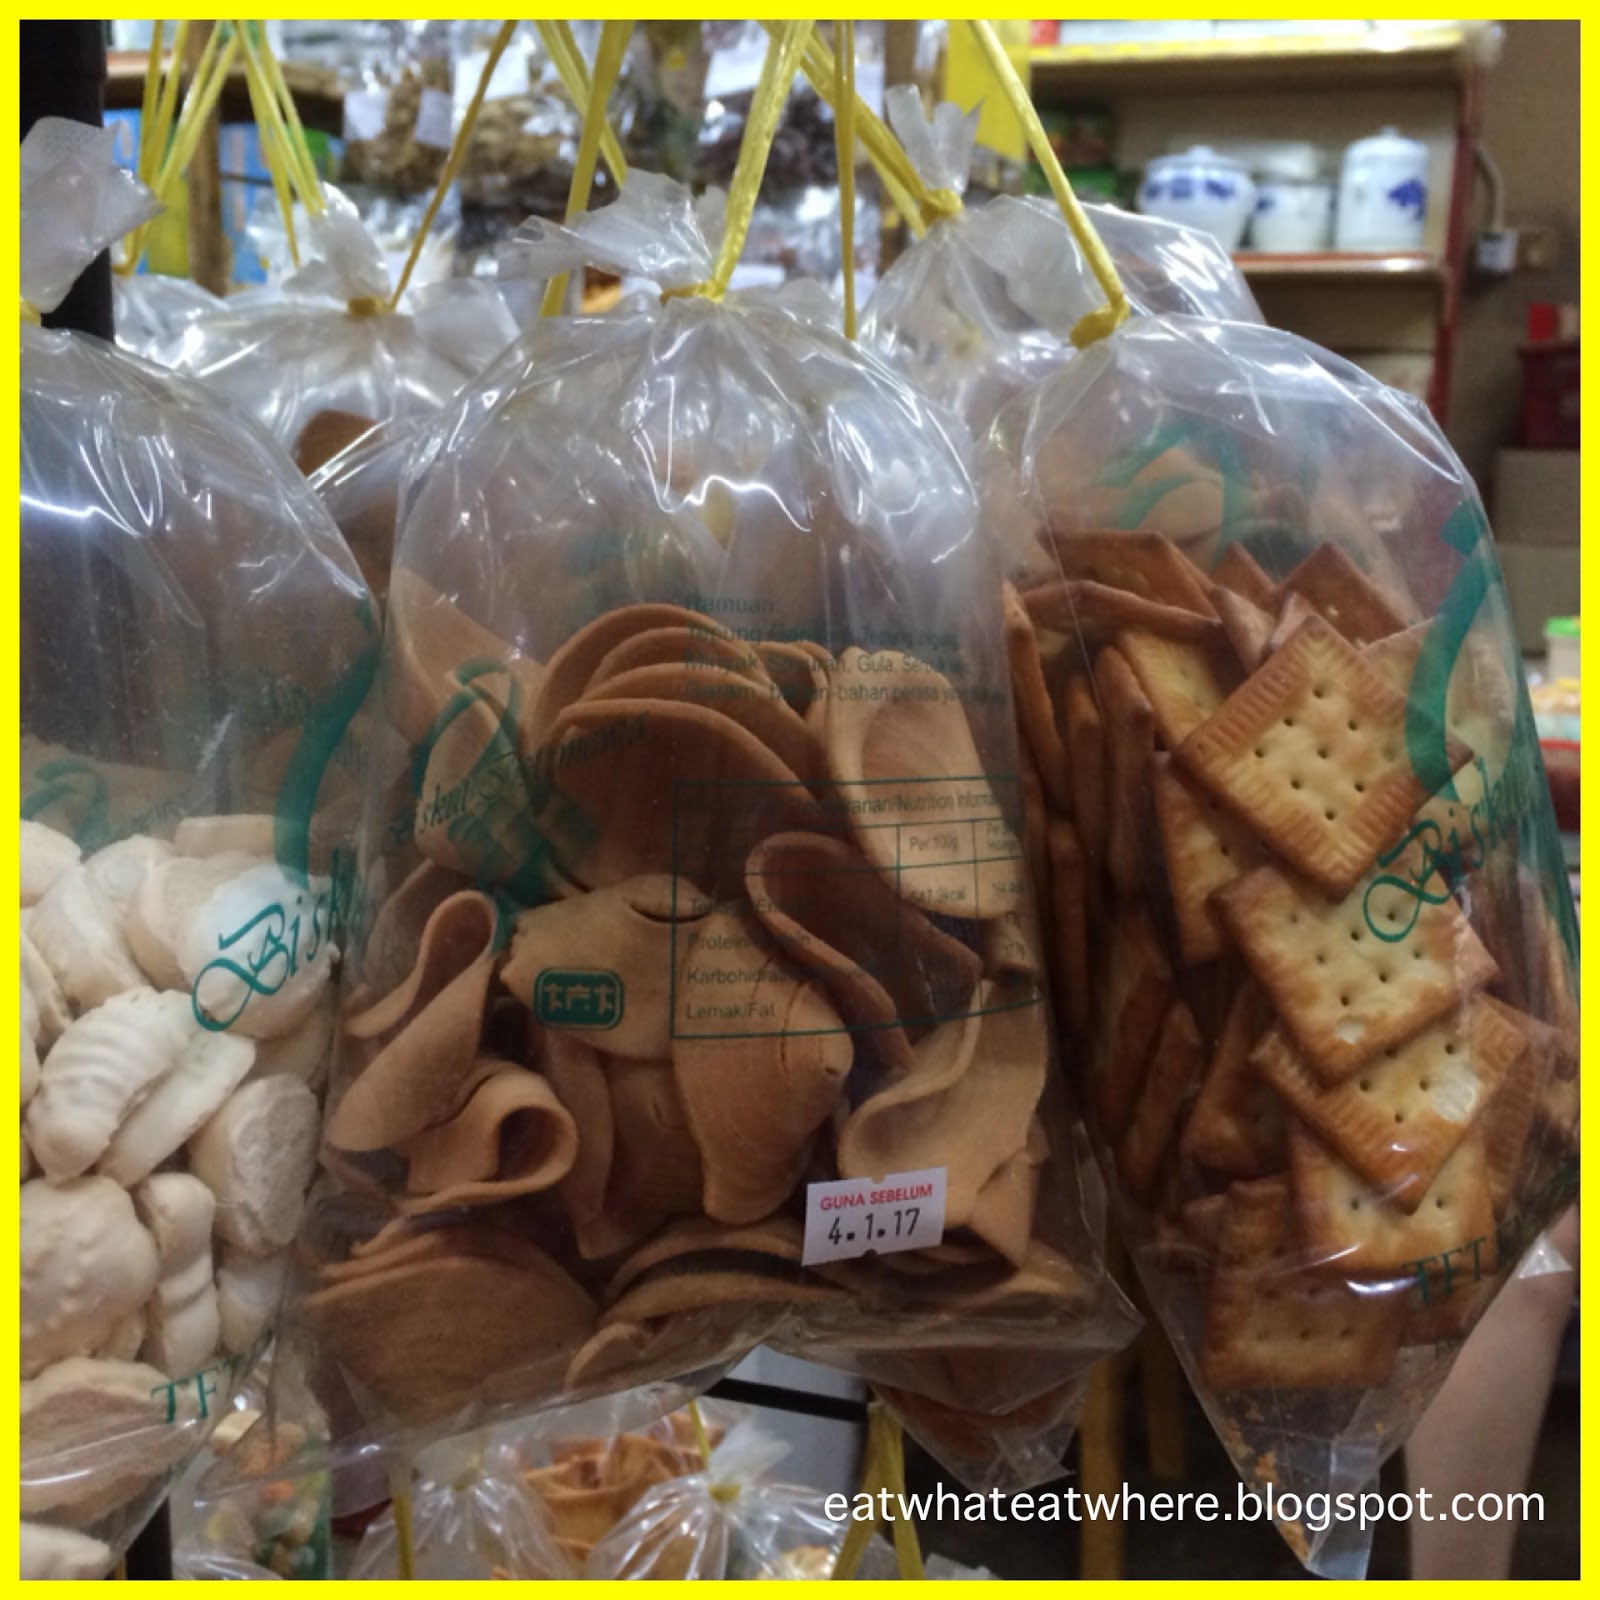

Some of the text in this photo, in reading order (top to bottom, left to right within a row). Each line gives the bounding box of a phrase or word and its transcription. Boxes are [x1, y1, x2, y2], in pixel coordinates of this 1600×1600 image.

[686, 1003, 776, 1020] Lemak/Fat
[819, 1183, 933, 1211] GUNA SEBELUM
[828, 1206, 921, 1246] 4.1.17
